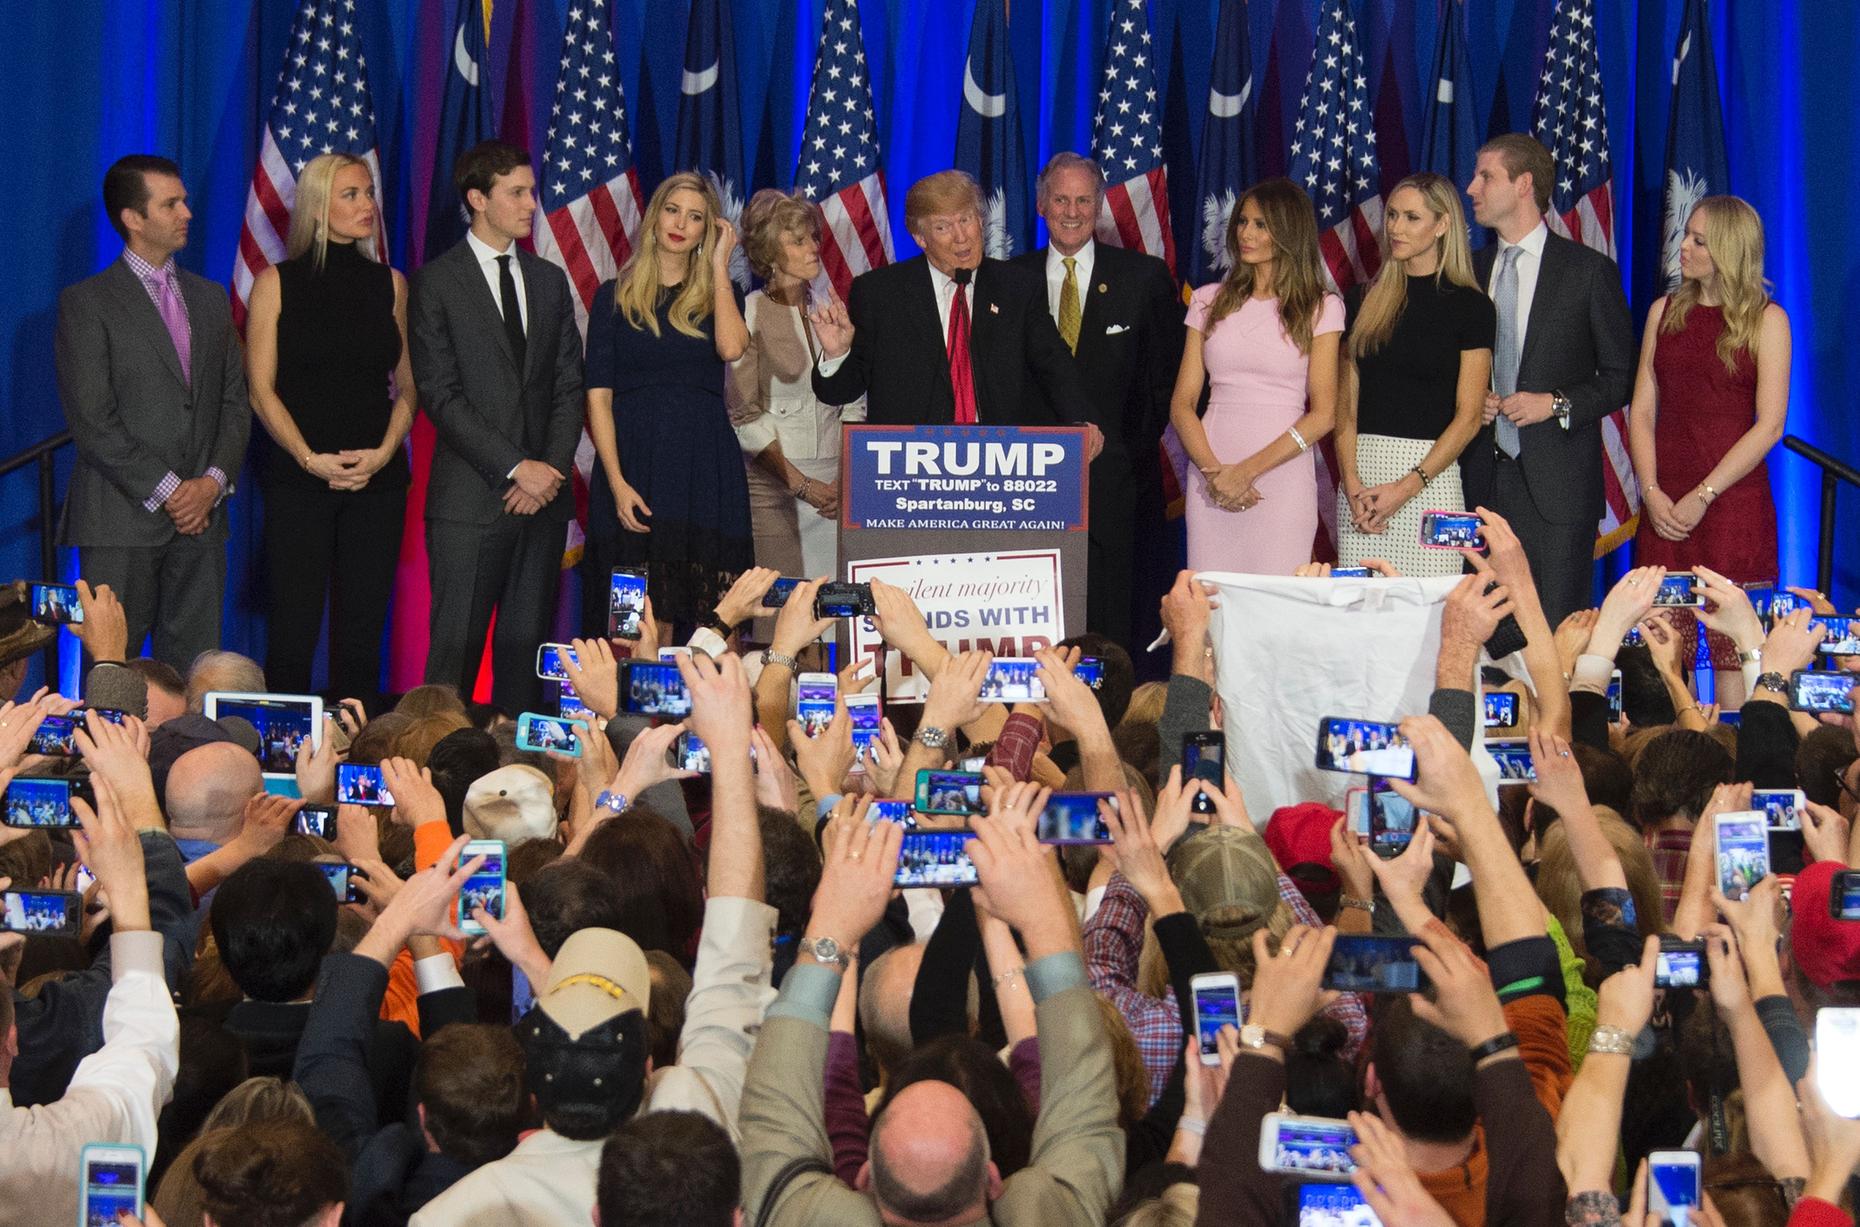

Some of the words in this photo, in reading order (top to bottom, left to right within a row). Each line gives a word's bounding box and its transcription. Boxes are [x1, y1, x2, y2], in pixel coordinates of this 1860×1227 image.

[866, 441, 1065, 476] TRUMP
[875, 480, 910, 491] TEXT
[986, 481, 1000, 491] to
[1003, 479, 1057, 492] 88022
[896, 497, 1007, 513] Spartanburg,
[1012, 498, 1035, 511] SC
[866, 518, 905, 528] MAKE
[908, 519, 969, 529] AMERICA
[972, 519, 1016, 529] GREAT
[1019, 520, 1065, 530] AGAIN!
[906, 576, 953, 600] ilent
[957, 574, 1048, 603] majority
[979, 606, 1050, 626] WITH
